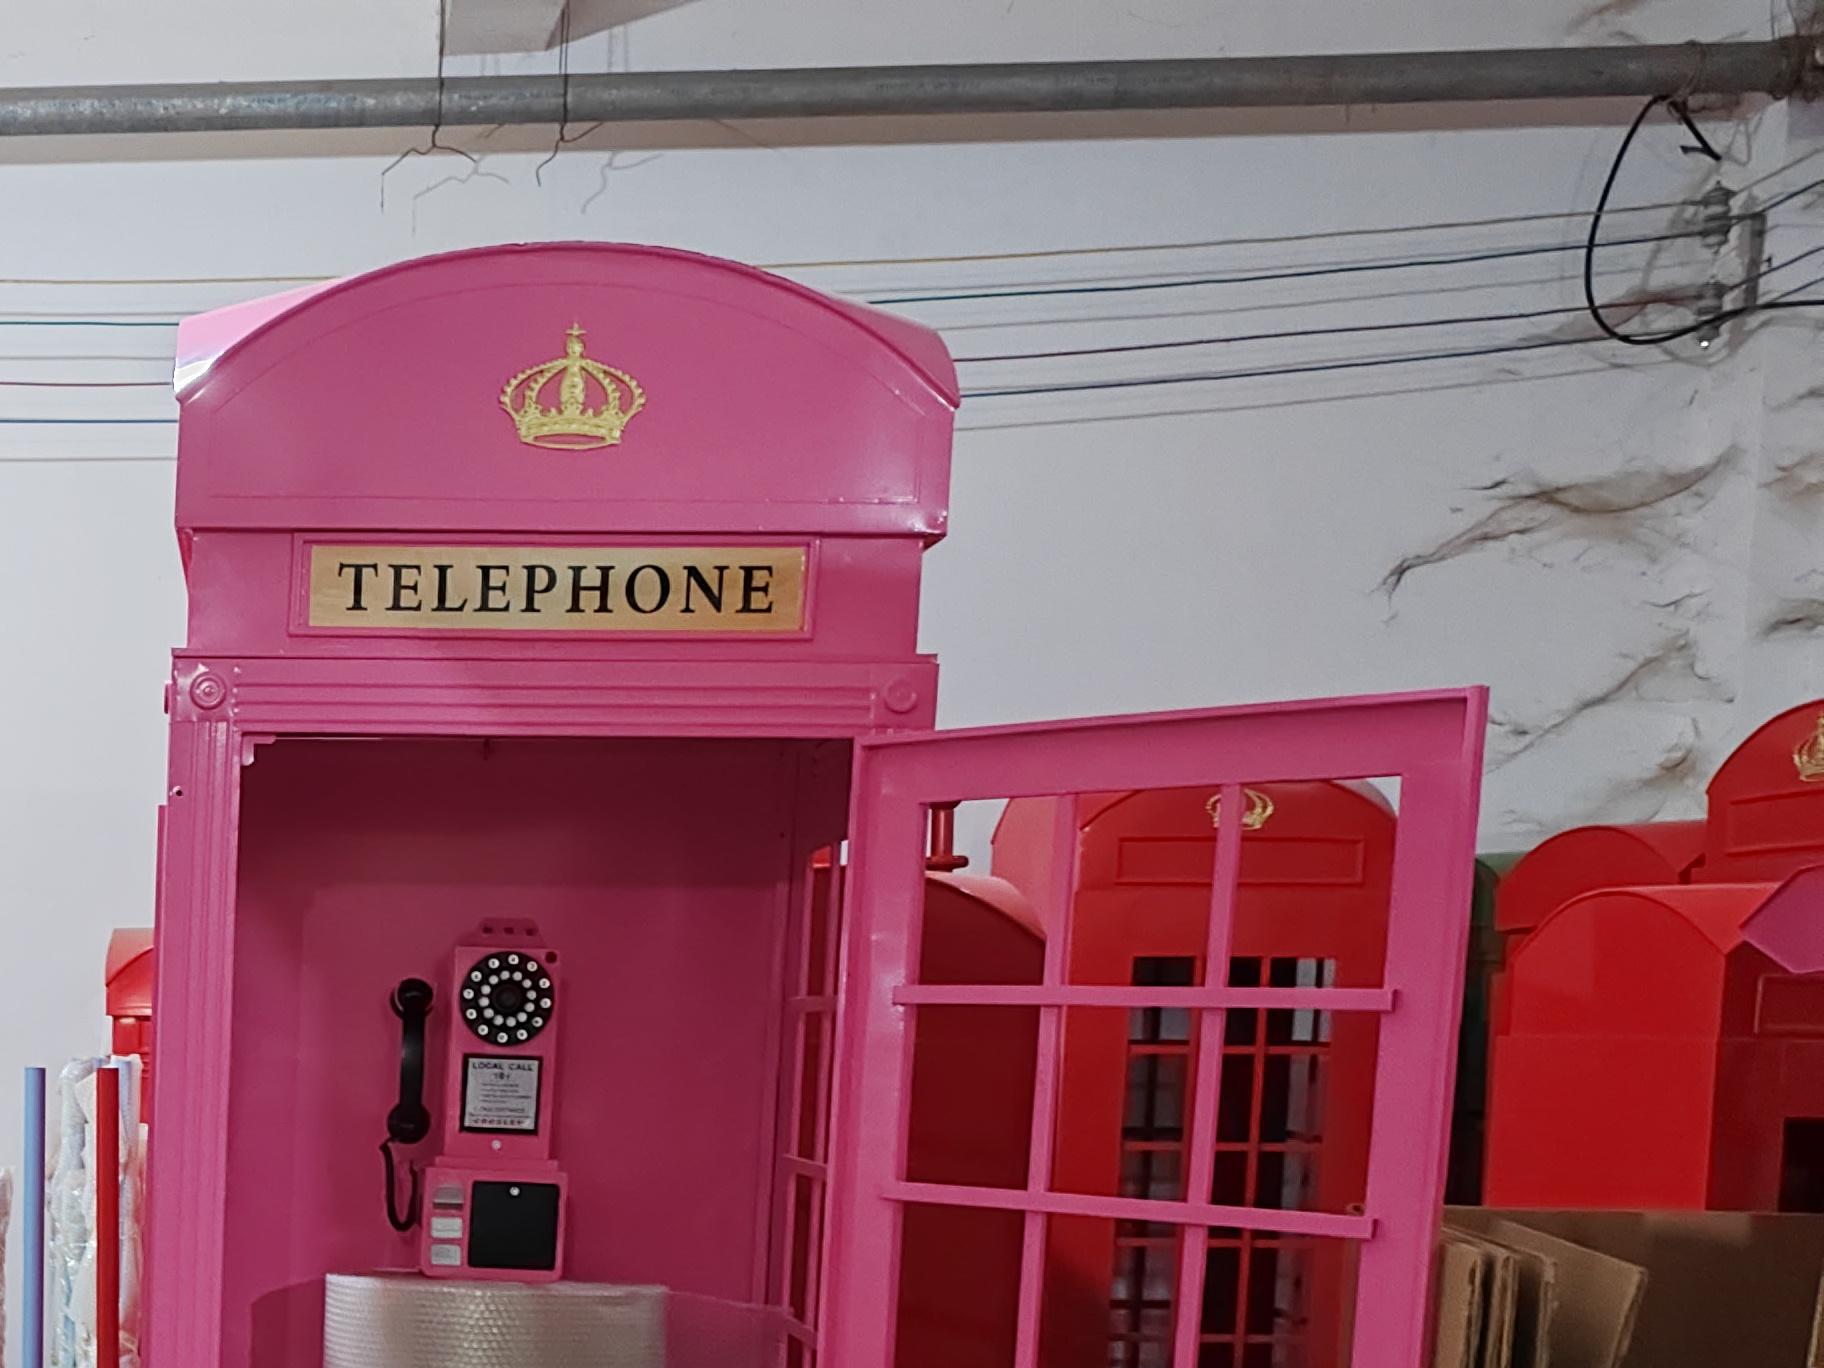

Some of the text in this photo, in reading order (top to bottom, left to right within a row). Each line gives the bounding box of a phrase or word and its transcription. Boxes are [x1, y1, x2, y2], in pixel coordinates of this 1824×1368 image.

[338, 562, 775, 615] TELEPHONE
[472, 1062, 534, 1072] LOCAL CALL
